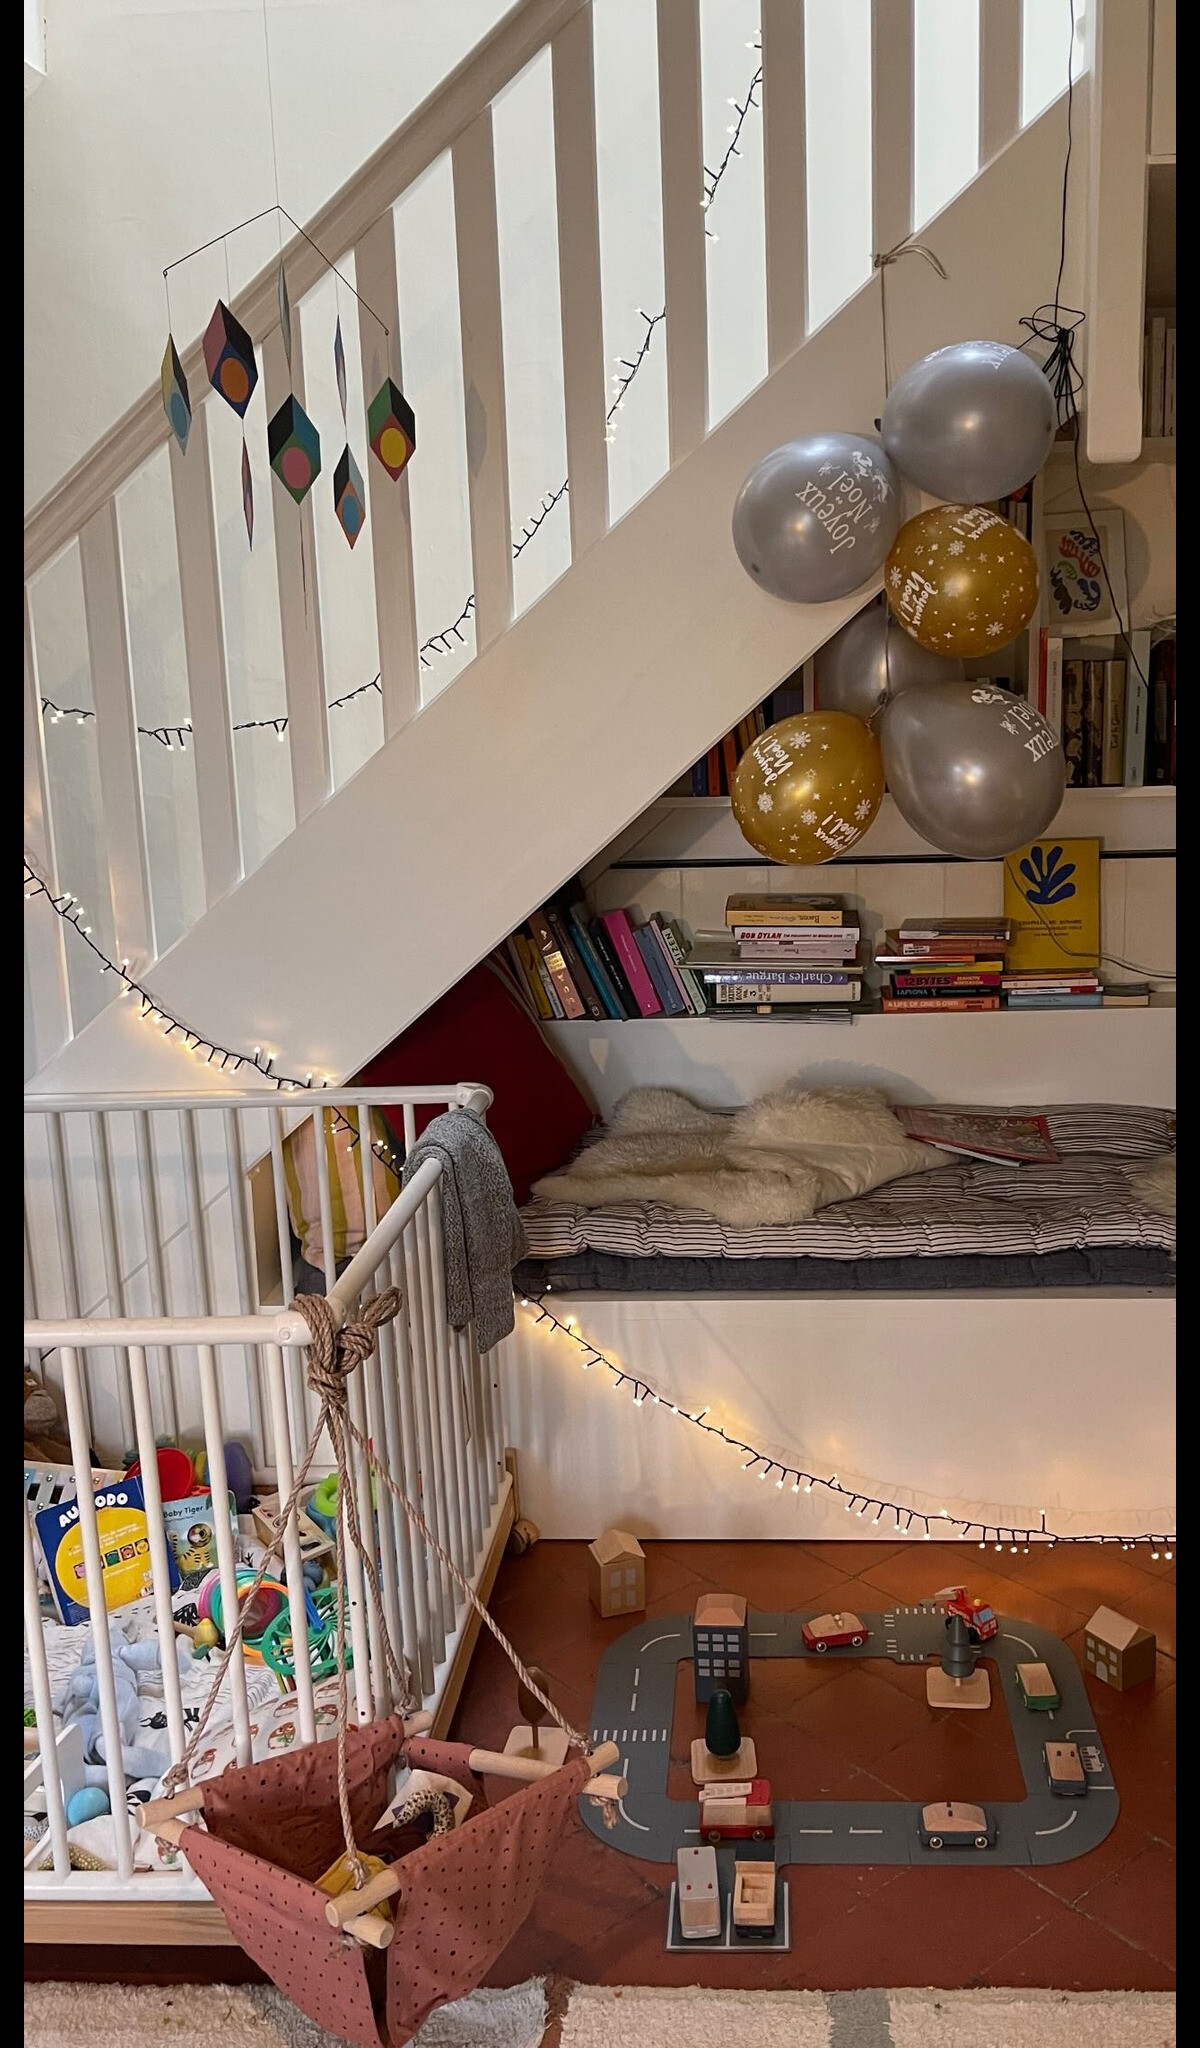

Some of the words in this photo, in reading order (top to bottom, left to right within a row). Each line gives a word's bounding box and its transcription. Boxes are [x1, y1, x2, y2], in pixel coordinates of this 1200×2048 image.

[827, 470, 873, 525] Noël
[795, 481, 856, 555] Joyeux
[912, 582, 939, 627] Joyeux
[752, 747, 778, 786] Joyeux
[745, 970, 786, 984] Bargue
[789, 972, 833, 984] Charles
[916, 977, 951, 986] BYTES
[163, 1509, 183, 1518] Baby
[184, 1505, 204, 1515] Tiger
